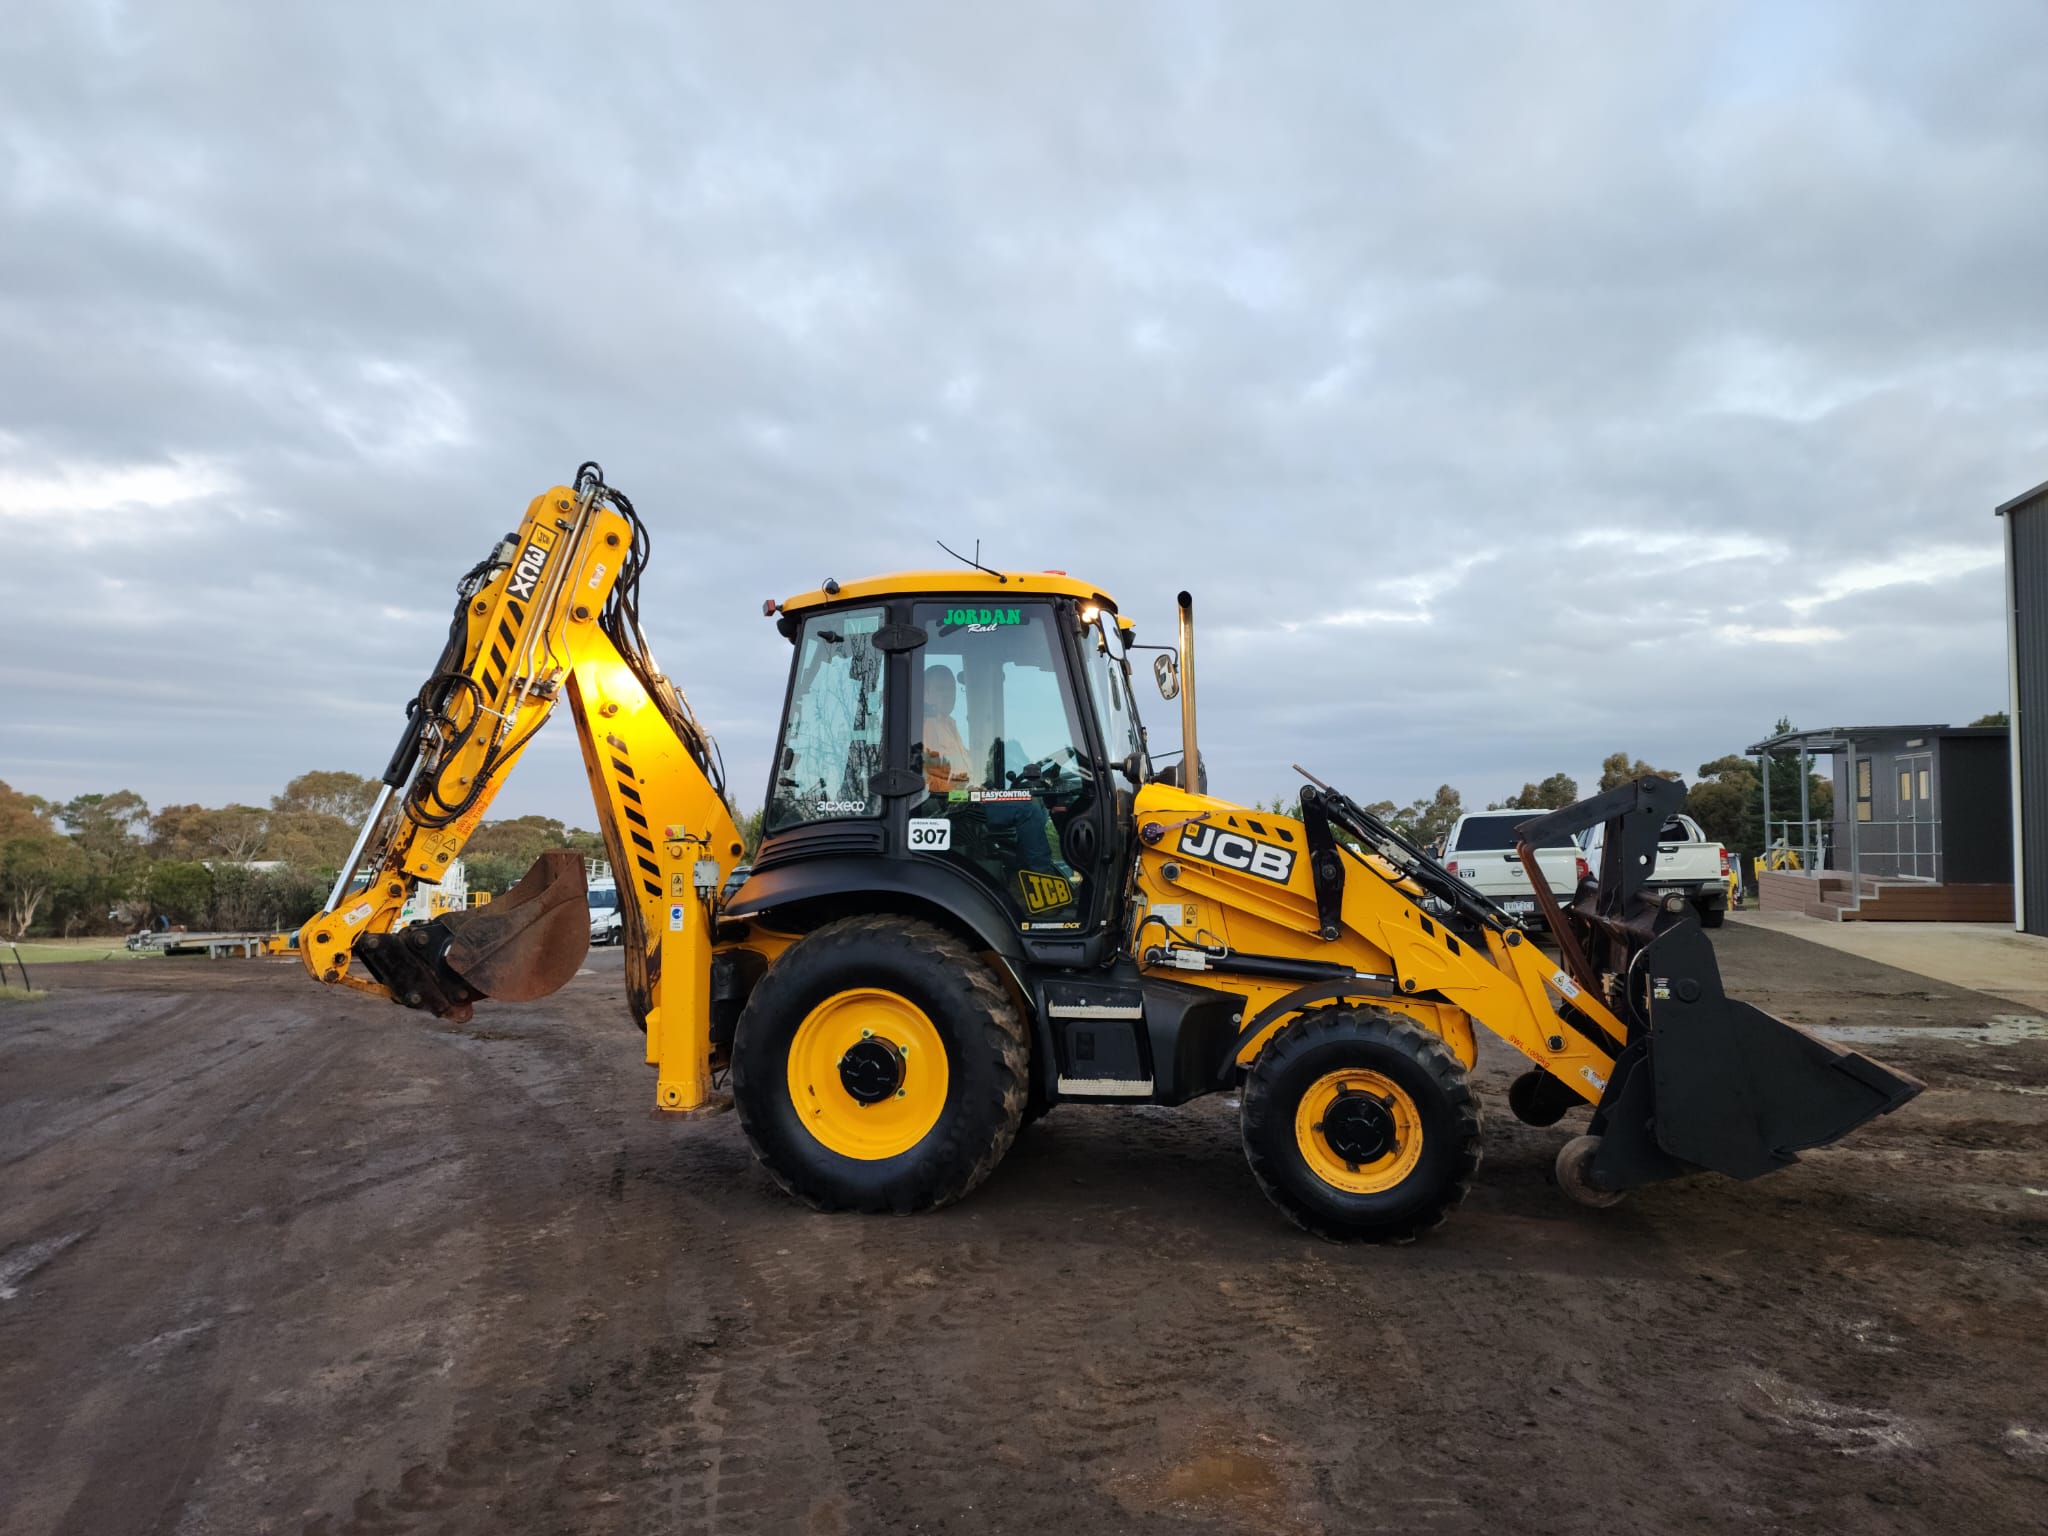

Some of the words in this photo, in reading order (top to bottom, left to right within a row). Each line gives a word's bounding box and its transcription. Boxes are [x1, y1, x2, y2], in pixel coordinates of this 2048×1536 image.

[508, 545, 546, 599] 3CX
[943, 608, 1021, 625] JORDAN
[967, 622, 998, 633] Rail
[981, 790, 1032, 799] EASYCONTROL
[912, 828, 948, 845] 307
[1181, 828, 1292, 880] JCB
[1028, 874, 1070, 909] JCB
[1508, 1034, 1523, 1049] SWL
